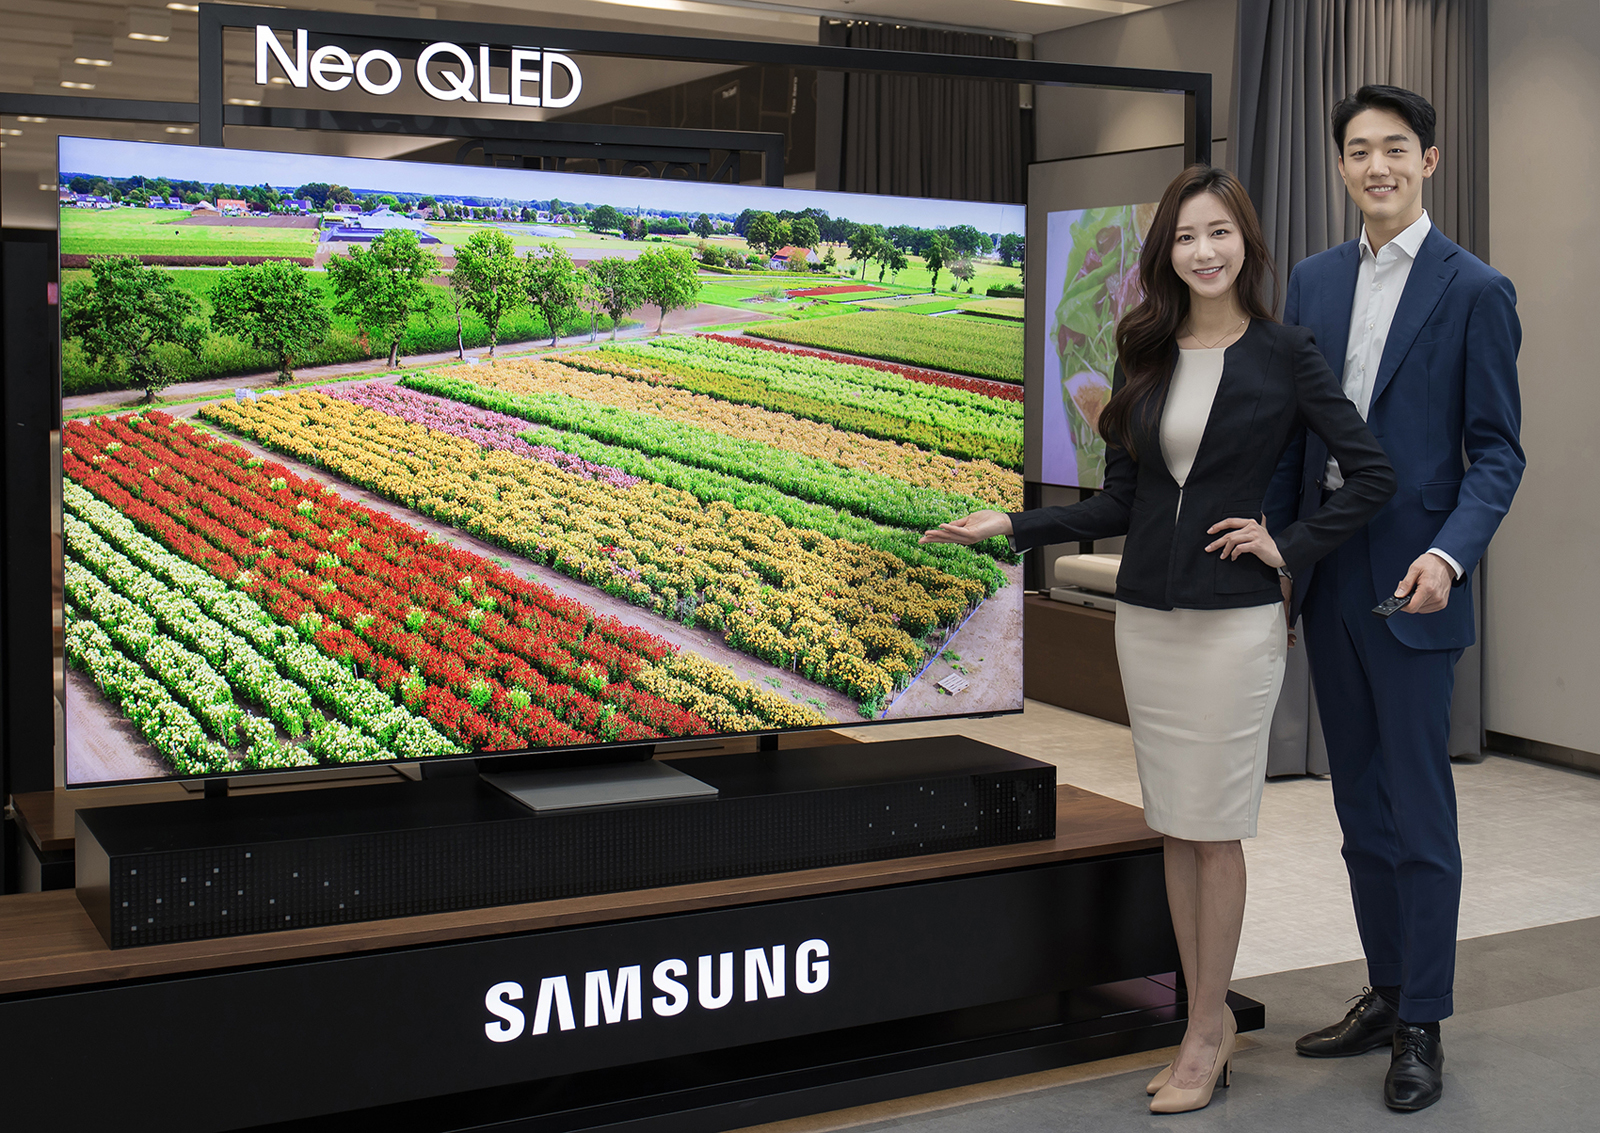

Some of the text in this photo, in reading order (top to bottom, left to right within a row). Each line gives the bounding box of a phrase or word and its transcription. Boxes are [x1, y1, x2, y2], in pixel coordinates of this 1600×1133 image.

[256, 25, 582, 108] Neo QLED
[484, 939, 830, 1042] SAMSUNG
